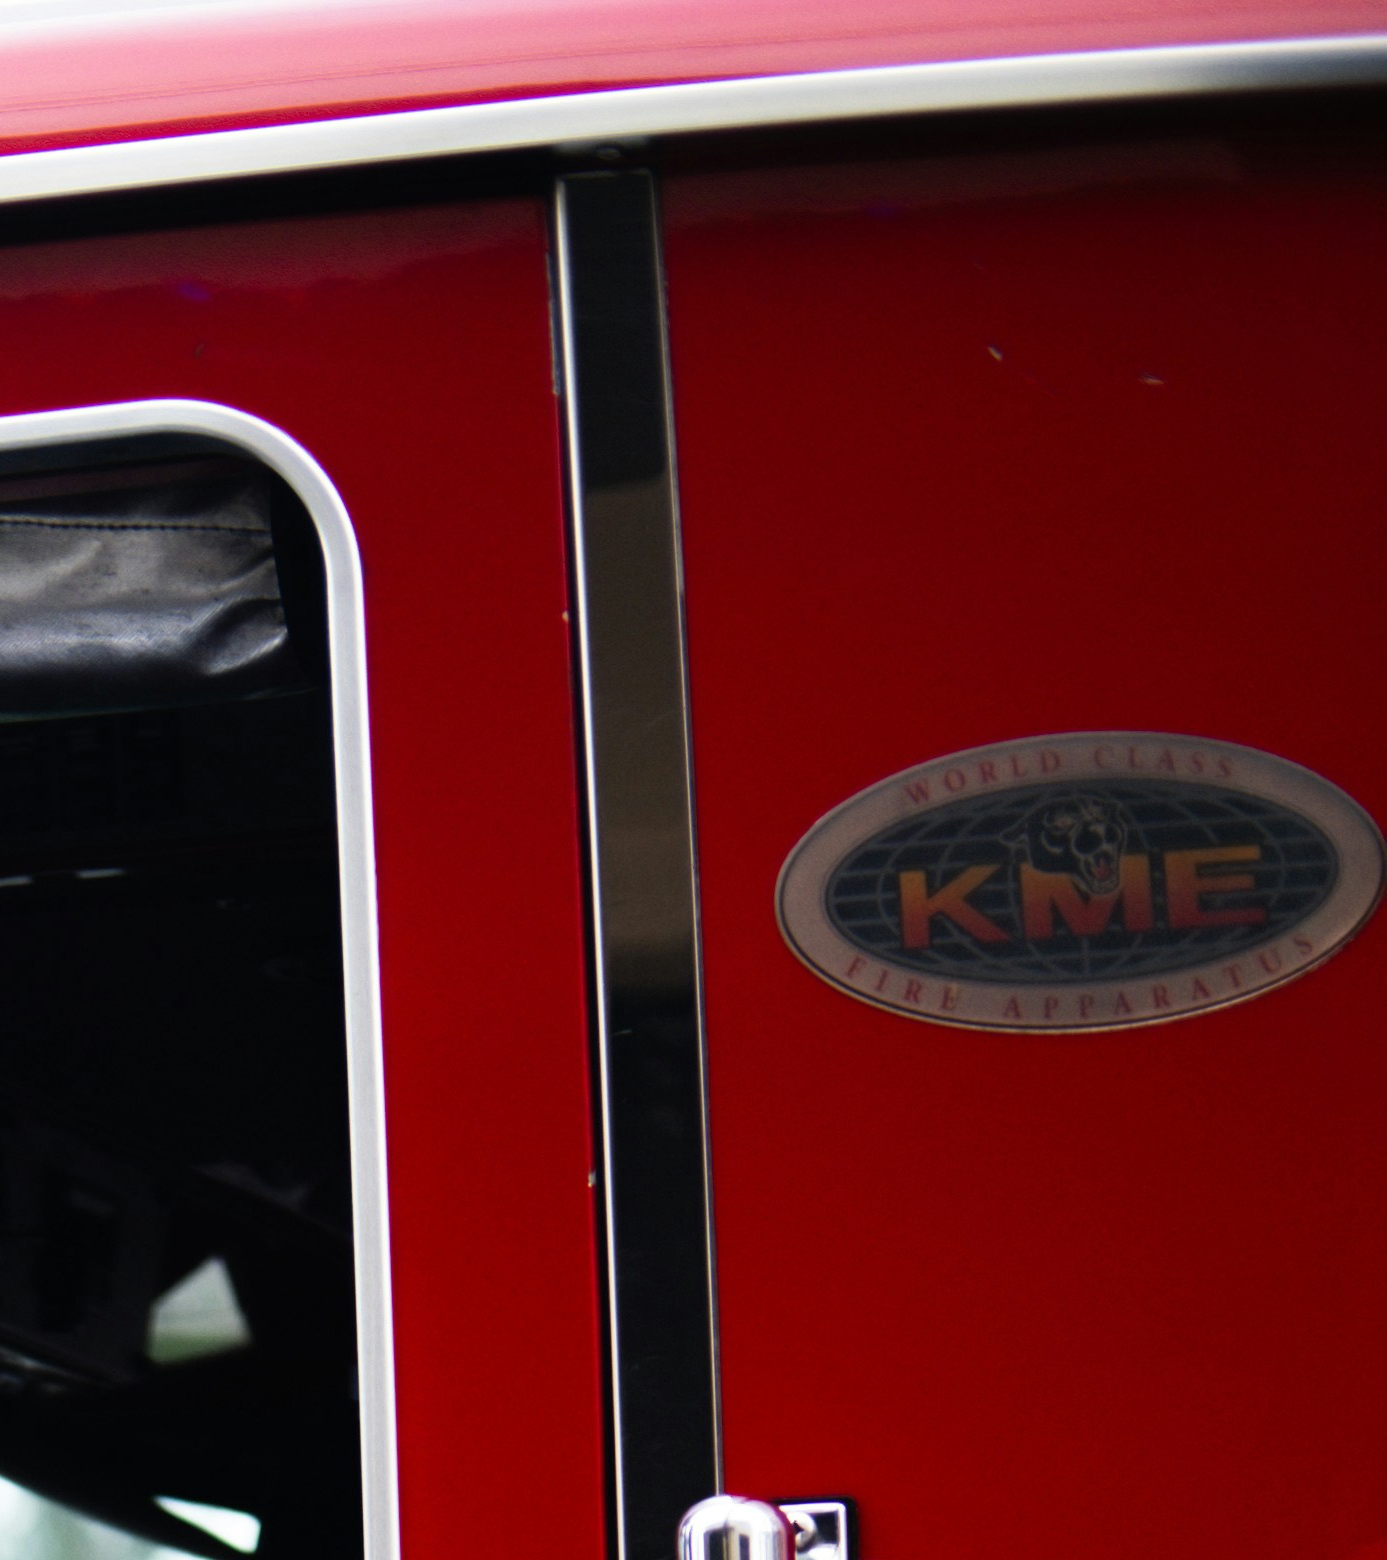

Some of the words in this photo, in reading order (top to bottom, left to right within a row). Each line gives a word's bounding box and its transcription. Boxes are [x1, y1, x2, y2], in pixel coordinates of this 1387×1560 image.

[904, 751, 1062, 805] WORLD
[1094, 746, 1234, 779] CLASS
[899, 844, 1268, 950] KME
[843, 956, 961, 1012] FIRE
[1002, 934, 1315, 1019] APPARATUS
